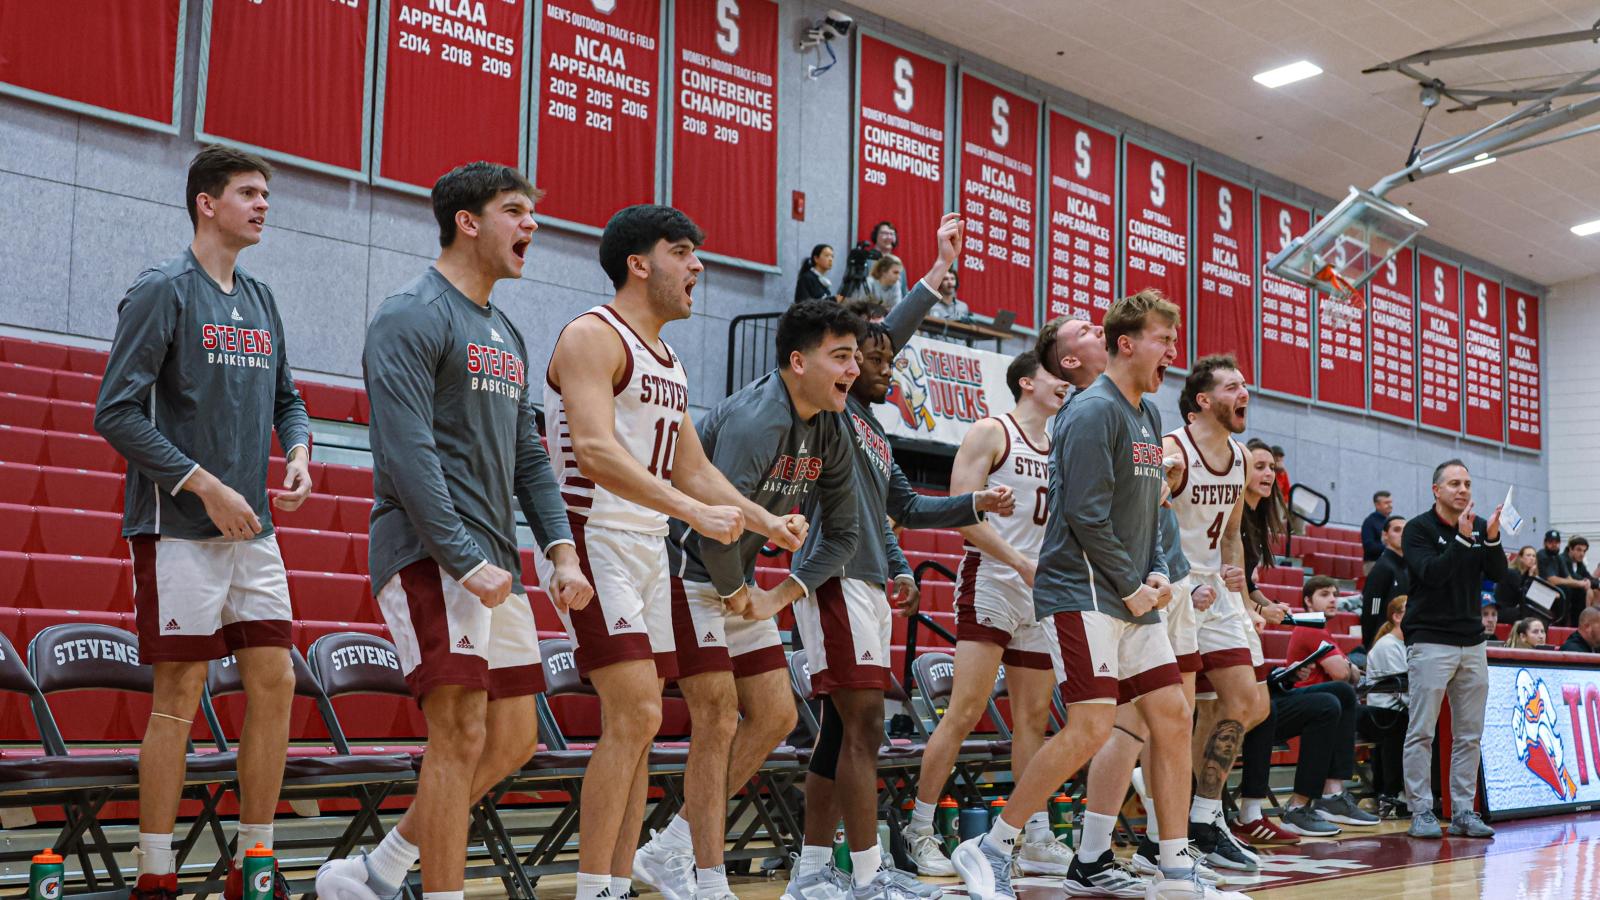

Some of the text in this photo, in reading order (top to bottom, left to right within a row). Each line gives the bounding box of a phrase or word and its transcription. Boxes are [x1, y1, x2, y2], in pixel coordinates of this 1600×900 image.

[399, 5, 514, 56] APPEARANCES
[547, 4, 571, 23] MEN'S
[571, 13, 605, 34] OUTDOOR
[606, 24, 628, 42] TRACK
[636, 33, 655, 50] FIELD
[716, 0, 739, 54] S
[399, 31, 511, 78] 2014 2018 2019
[575, 34, 626, 70] NCAA
[549, 53, 650, 97] APPEARANCES
[682, 68, 772, 110] CONFERENCE
[893, 56, 914, 112] S
[550, 77, 648, 119] 2012 2015 2016
[681, 89, 772, 132] CHAMPIONS
[548, 100, 612, 132] 2018 2021
[682, 115, 739, 144] 2018 2019
[991, 95, 1009, 147] S
[864, 125, 939, 162] CONFERENCE
[1075, 130, 1092, 179] S
[864, 143, 940, 181] CHAMPIONS
[864, 167, 886, 186] 2019
[981, 164, 1016, 193] NCAA
[965, 179, 1031, 214] APPEARANCES
[1151, 160, 1165, 207] S
[966, 199, 1030, 232] 2013 2014 2015
[1052, 210, 1110, 242] APPEARANCES
[1067, 195, 1097, 222] NCAA
[1218, 187, 1232, 231] S
[989, 225, 1007, 242] 2017
[1128, 235, 1185, 266] CHAMPIONS
[1129, 219, 1185, 250] CONFERENCE
[964, 254, 985, 272] 2024
[988, 243, 1008, 260] 2022
[1212, 247, 1239, 269] NCAA
[1202, 261, 1251, 287] APPEARANCES
[1263, 278, 1307, 304] CHAMPIONS
[1434, 265, 1444, 304] S
[1372, 297, 1411, 320] CONFERENCE
[1477, 282, 1488, 319] S
[1517, 297, 1526, 333] S
[1372, 310, 1411, 334] CHAMPIONS
[1430, 316, 1449, 335] NCAA
[1466, 329, 1500, 350] CONFERENCE
[202, 324, 272, 356] STEVENS
[1466, 342, 1500, 363] CHAMPIONS
[1514, 345, 1531, 360] NCAA
[208, 352, 270, 369] BASKETBALL
[467, 342, 525, 389] STEVEN
[921, 348, 983, 387] STEVENS
[640, 374, 688, 414] STEVEN
[928, 379, 990, 423] DUCKS
[647, 417, 680, 480] 10
[1207, 511, 1225, 550] 4
[54, 639, 140, 667] STEVENS
[331, 645, 399, 671] STEVENS
